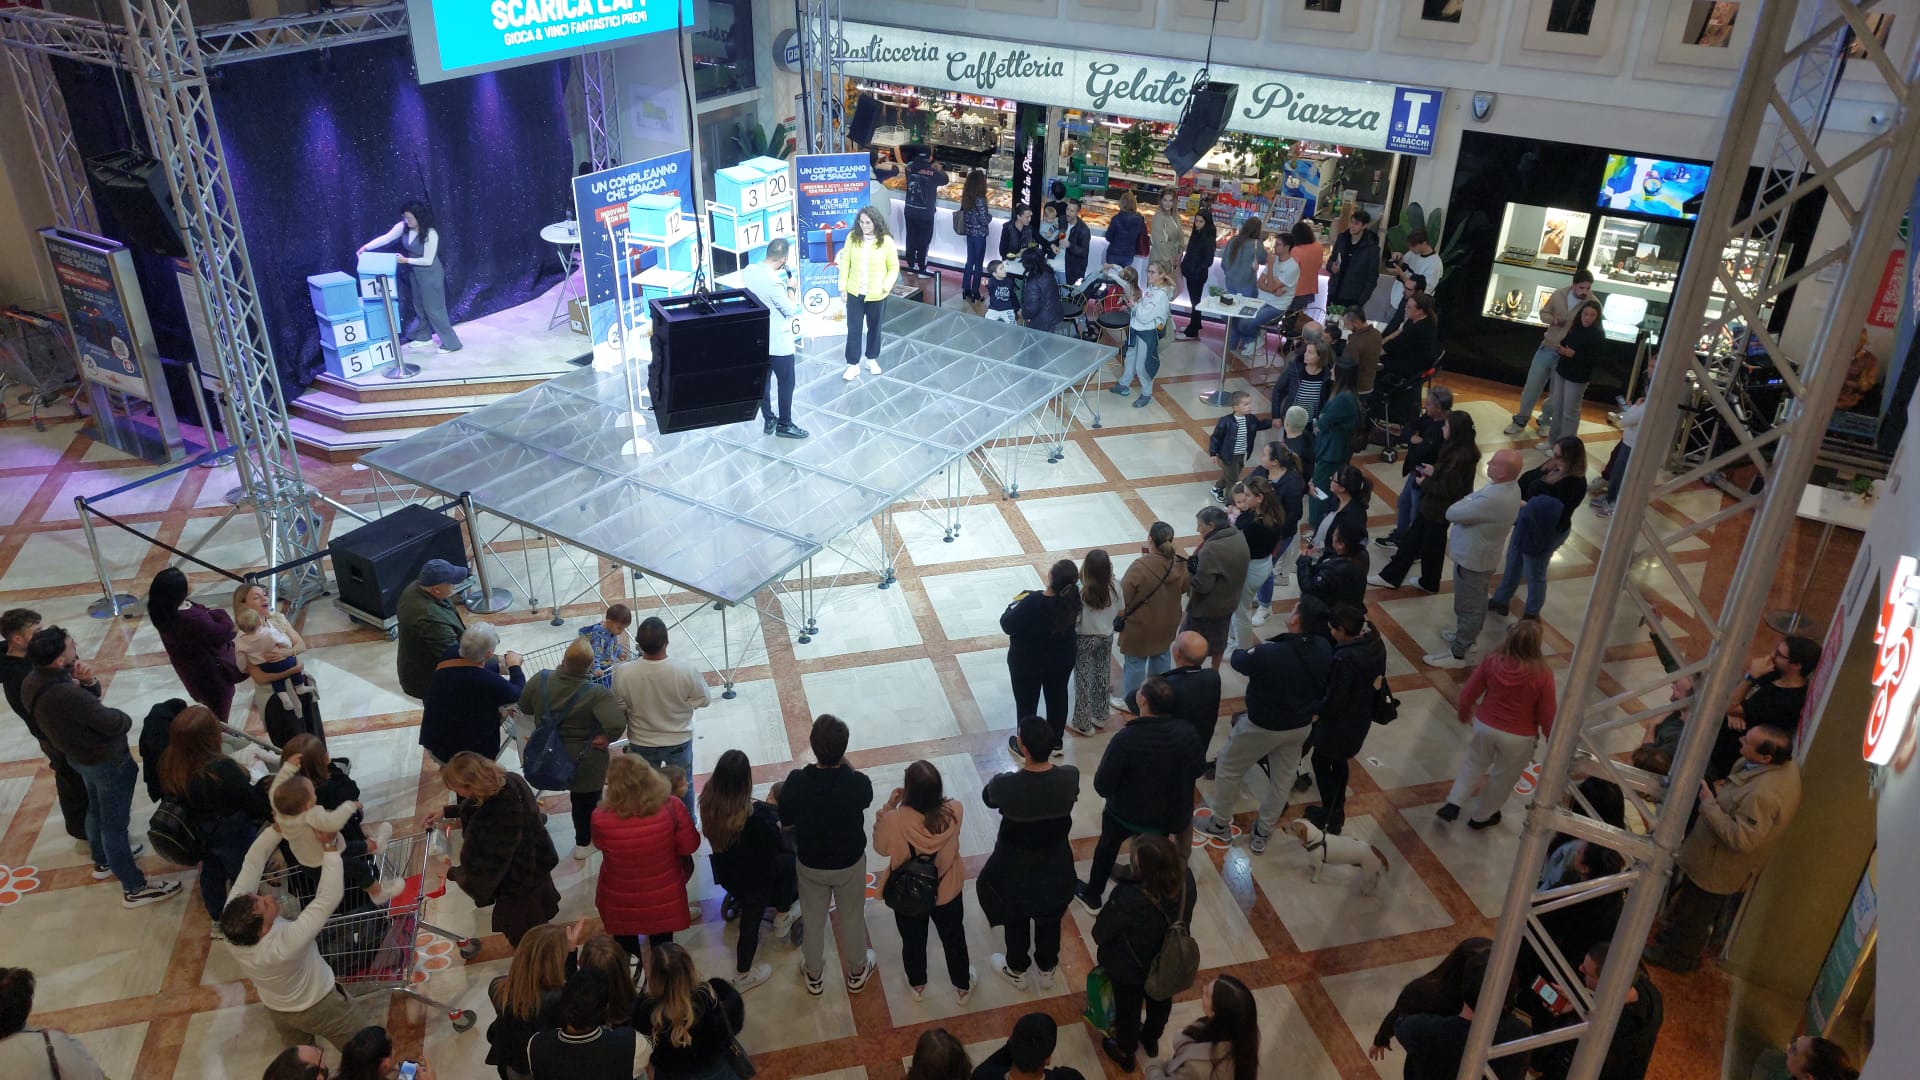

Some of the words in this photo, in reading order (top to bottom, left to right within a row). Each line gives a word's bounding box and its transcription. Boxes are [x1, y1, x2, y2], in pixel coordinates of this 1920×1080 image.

[503, 28, 535, 46] GIOCA
[534, 27, 543, 41] &
[543, 23, 570, 39] VINCI
[570, 15, 621, 34] FANTASTICI
[621, 10, 648, 26] PREMI
[946, 49, 1064, 90] Caffetteria
[1085, 61, 1190, 110] Gelato
[1243, 82, 1381, 132] Piazza
[1403, 91, 1432, 134] T
[1391, 135, 1430, 147] TABACCHI
[591, 180, 608, 194] UN
[608, 162, 678, 190] COMPLEANNO
[812, 165, 866, 174] COMPLEANNO
[828, 172, 858, 180] SPACCA
[769, 174, 787, 197] 20
[1023, 174, 1032, 186] in
[606, 187, 628, 203] CHE
[627, 178, 667, 196] SPACCA
[748, 189, 758, 207] 3
[668, 212, 681, 235] 12
[775, 216, 785, 233] 4
[743, 224, 760, 245] 17
[809, 293, 823, 307] 25
[344, 325, 356, 342] 8
[791, 318, 801, 335] 6
[375, 342, 394, 361] 11
[350, 356, 363, 373] 5
